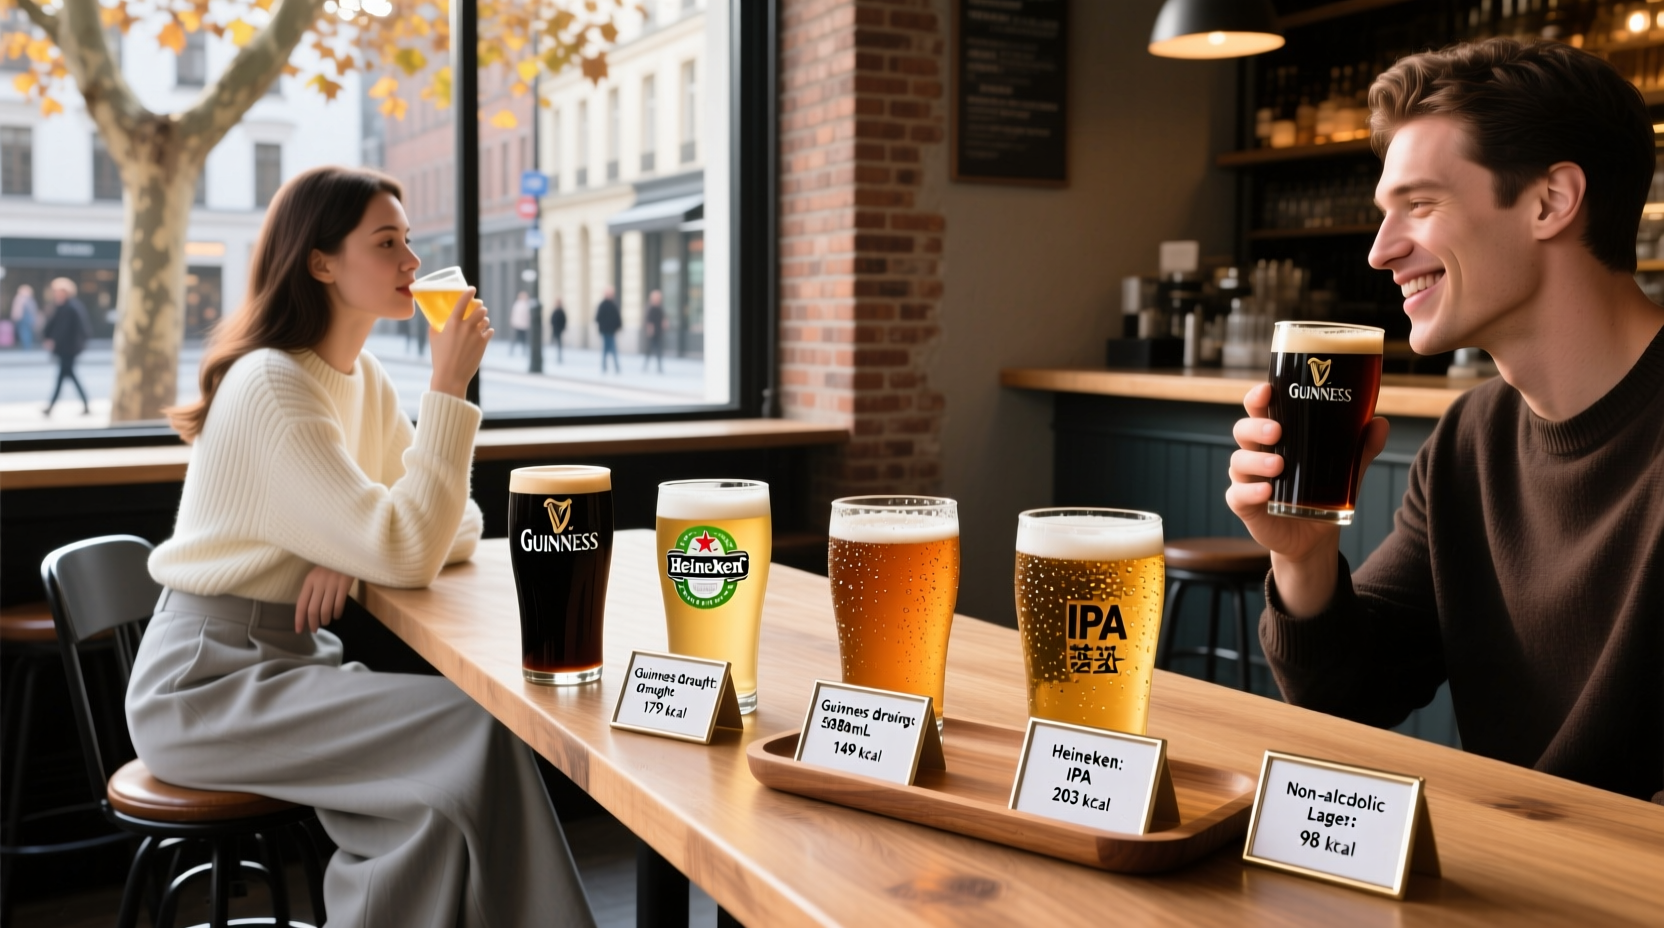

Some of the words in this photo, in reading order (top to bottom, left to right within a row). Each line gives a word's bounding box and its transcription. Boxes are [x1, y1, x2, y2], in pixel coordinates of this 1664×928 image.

[1288, 382, 1352, 402] GUINNESS
[520, 528, 599, 552] GUINNESS
[670, 557, 747, 574] Heineken
[1068, 604, 1127, 640] IPA
[644, 701, 664, 714] 179
[665, 705, 687, 719] kcal
[834, 741, 856, 756] 149
[858, 746, 882, 762] kcal
[1052, 744, 1124, 771] Heineken:
[1066, 767, 1092, 785] IPA
[1052, 786, 1080, 805] 203
[1082, 793, 1111, 812] kcal
[1300, 830, 1320, 848] 98
